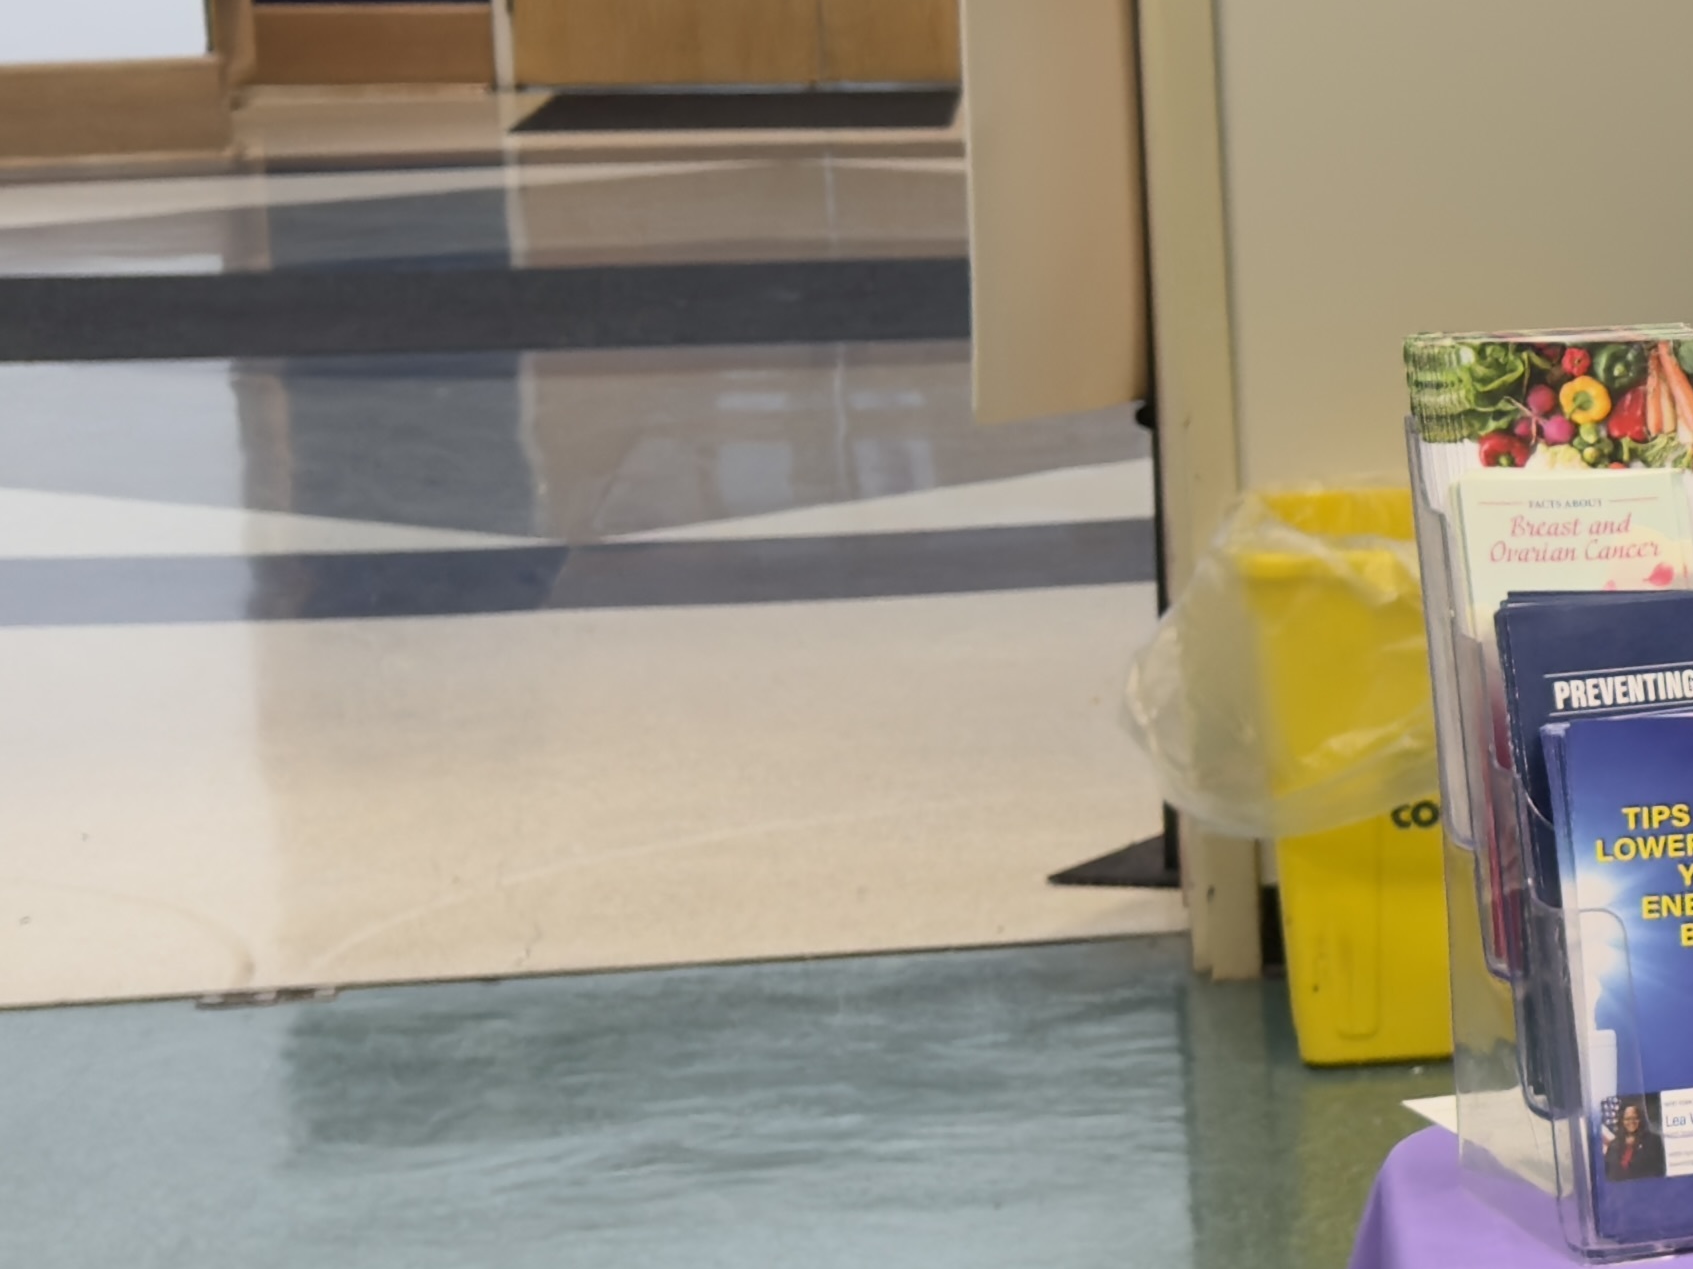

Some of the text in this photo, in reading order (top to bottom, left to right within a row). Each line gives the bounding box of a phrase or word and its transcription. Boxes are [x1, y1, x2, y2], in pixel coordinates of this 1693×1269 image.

[1529, 499, 1602, 509] FACTS ABOUT
[1510, 512, 1632, 538] Breast and
[1490, 539, 1660, 563] Ovarian Cancer
[1622, 804, 1691, 830] TIPS
[1665, 1115, 1686, 1128] Lea
